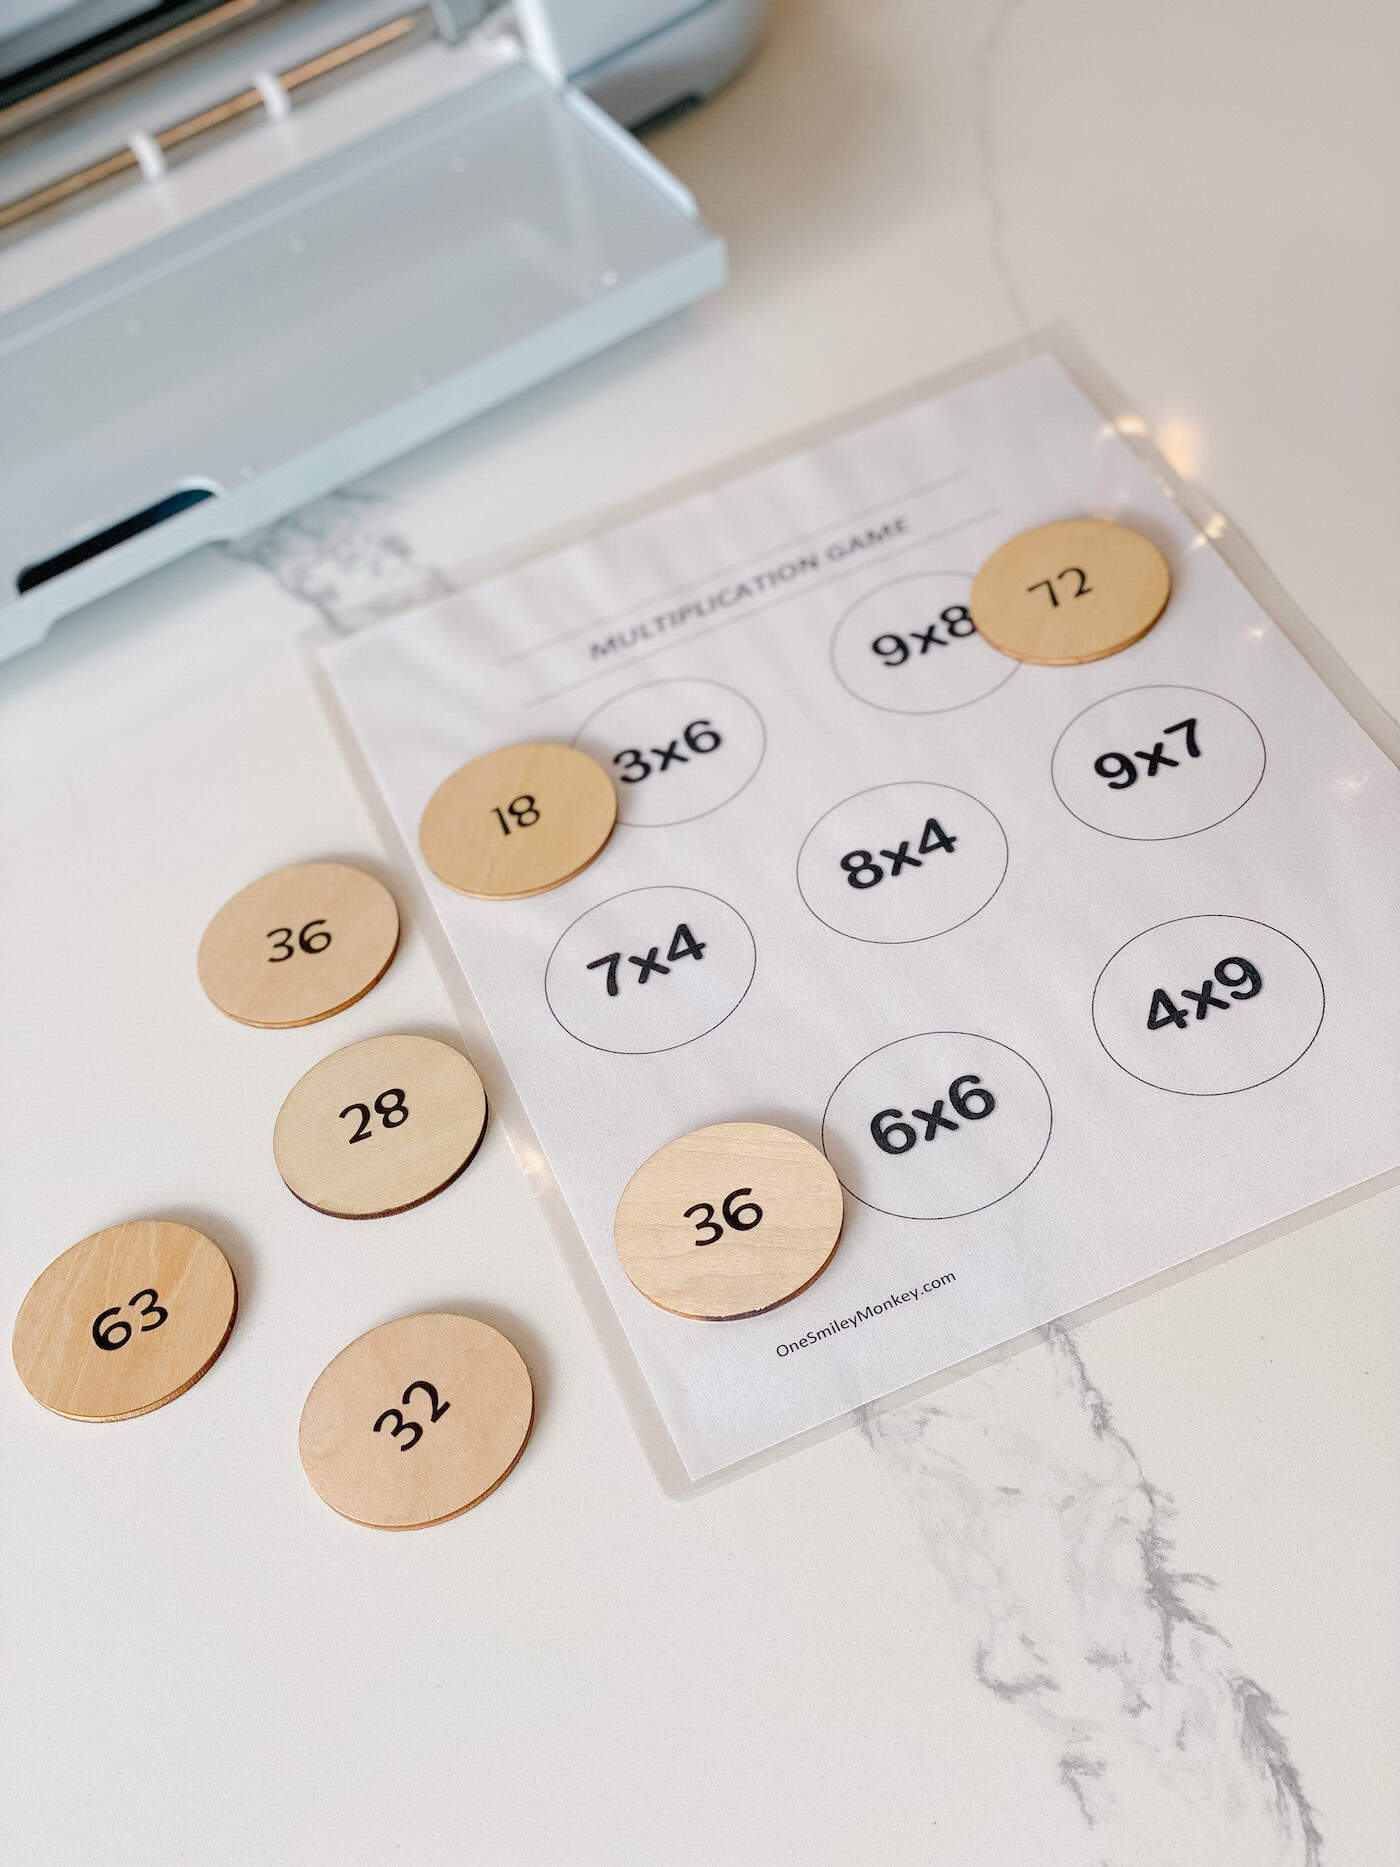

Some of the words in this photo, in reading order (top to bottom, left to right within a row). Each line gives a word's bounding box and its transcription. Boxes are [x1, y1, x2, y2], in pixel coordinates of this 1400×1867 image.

[590, 554, 820, 660] MULTIPLICATION
[825, 516, 908, 562] GAME
[1026, 566, 1093, 609] 72
[871, 605, 978, 667] 9x8
[612, 719, 723, 785] 3x6
[1093, 716, 1204, 791] 9x7
[492, 793, 541, 836] 18
[840, 816, 957, 890] 8x4
[266, 919, 332, 963] 36
[586, 923, 707, 998] 7x4
[1146, 956, 1263, 1031] 4x9
[338, 1088, 409, 1145] 28
[870, 1074, 996, 1155] 6x6
[683, 1187, 763, 1247] 36
[92, 1288, 169, 1351] 63
[775, 1271, 957, 1358] OneSmileyMonkey.com
[372, 1380, 451, 1452] 32
